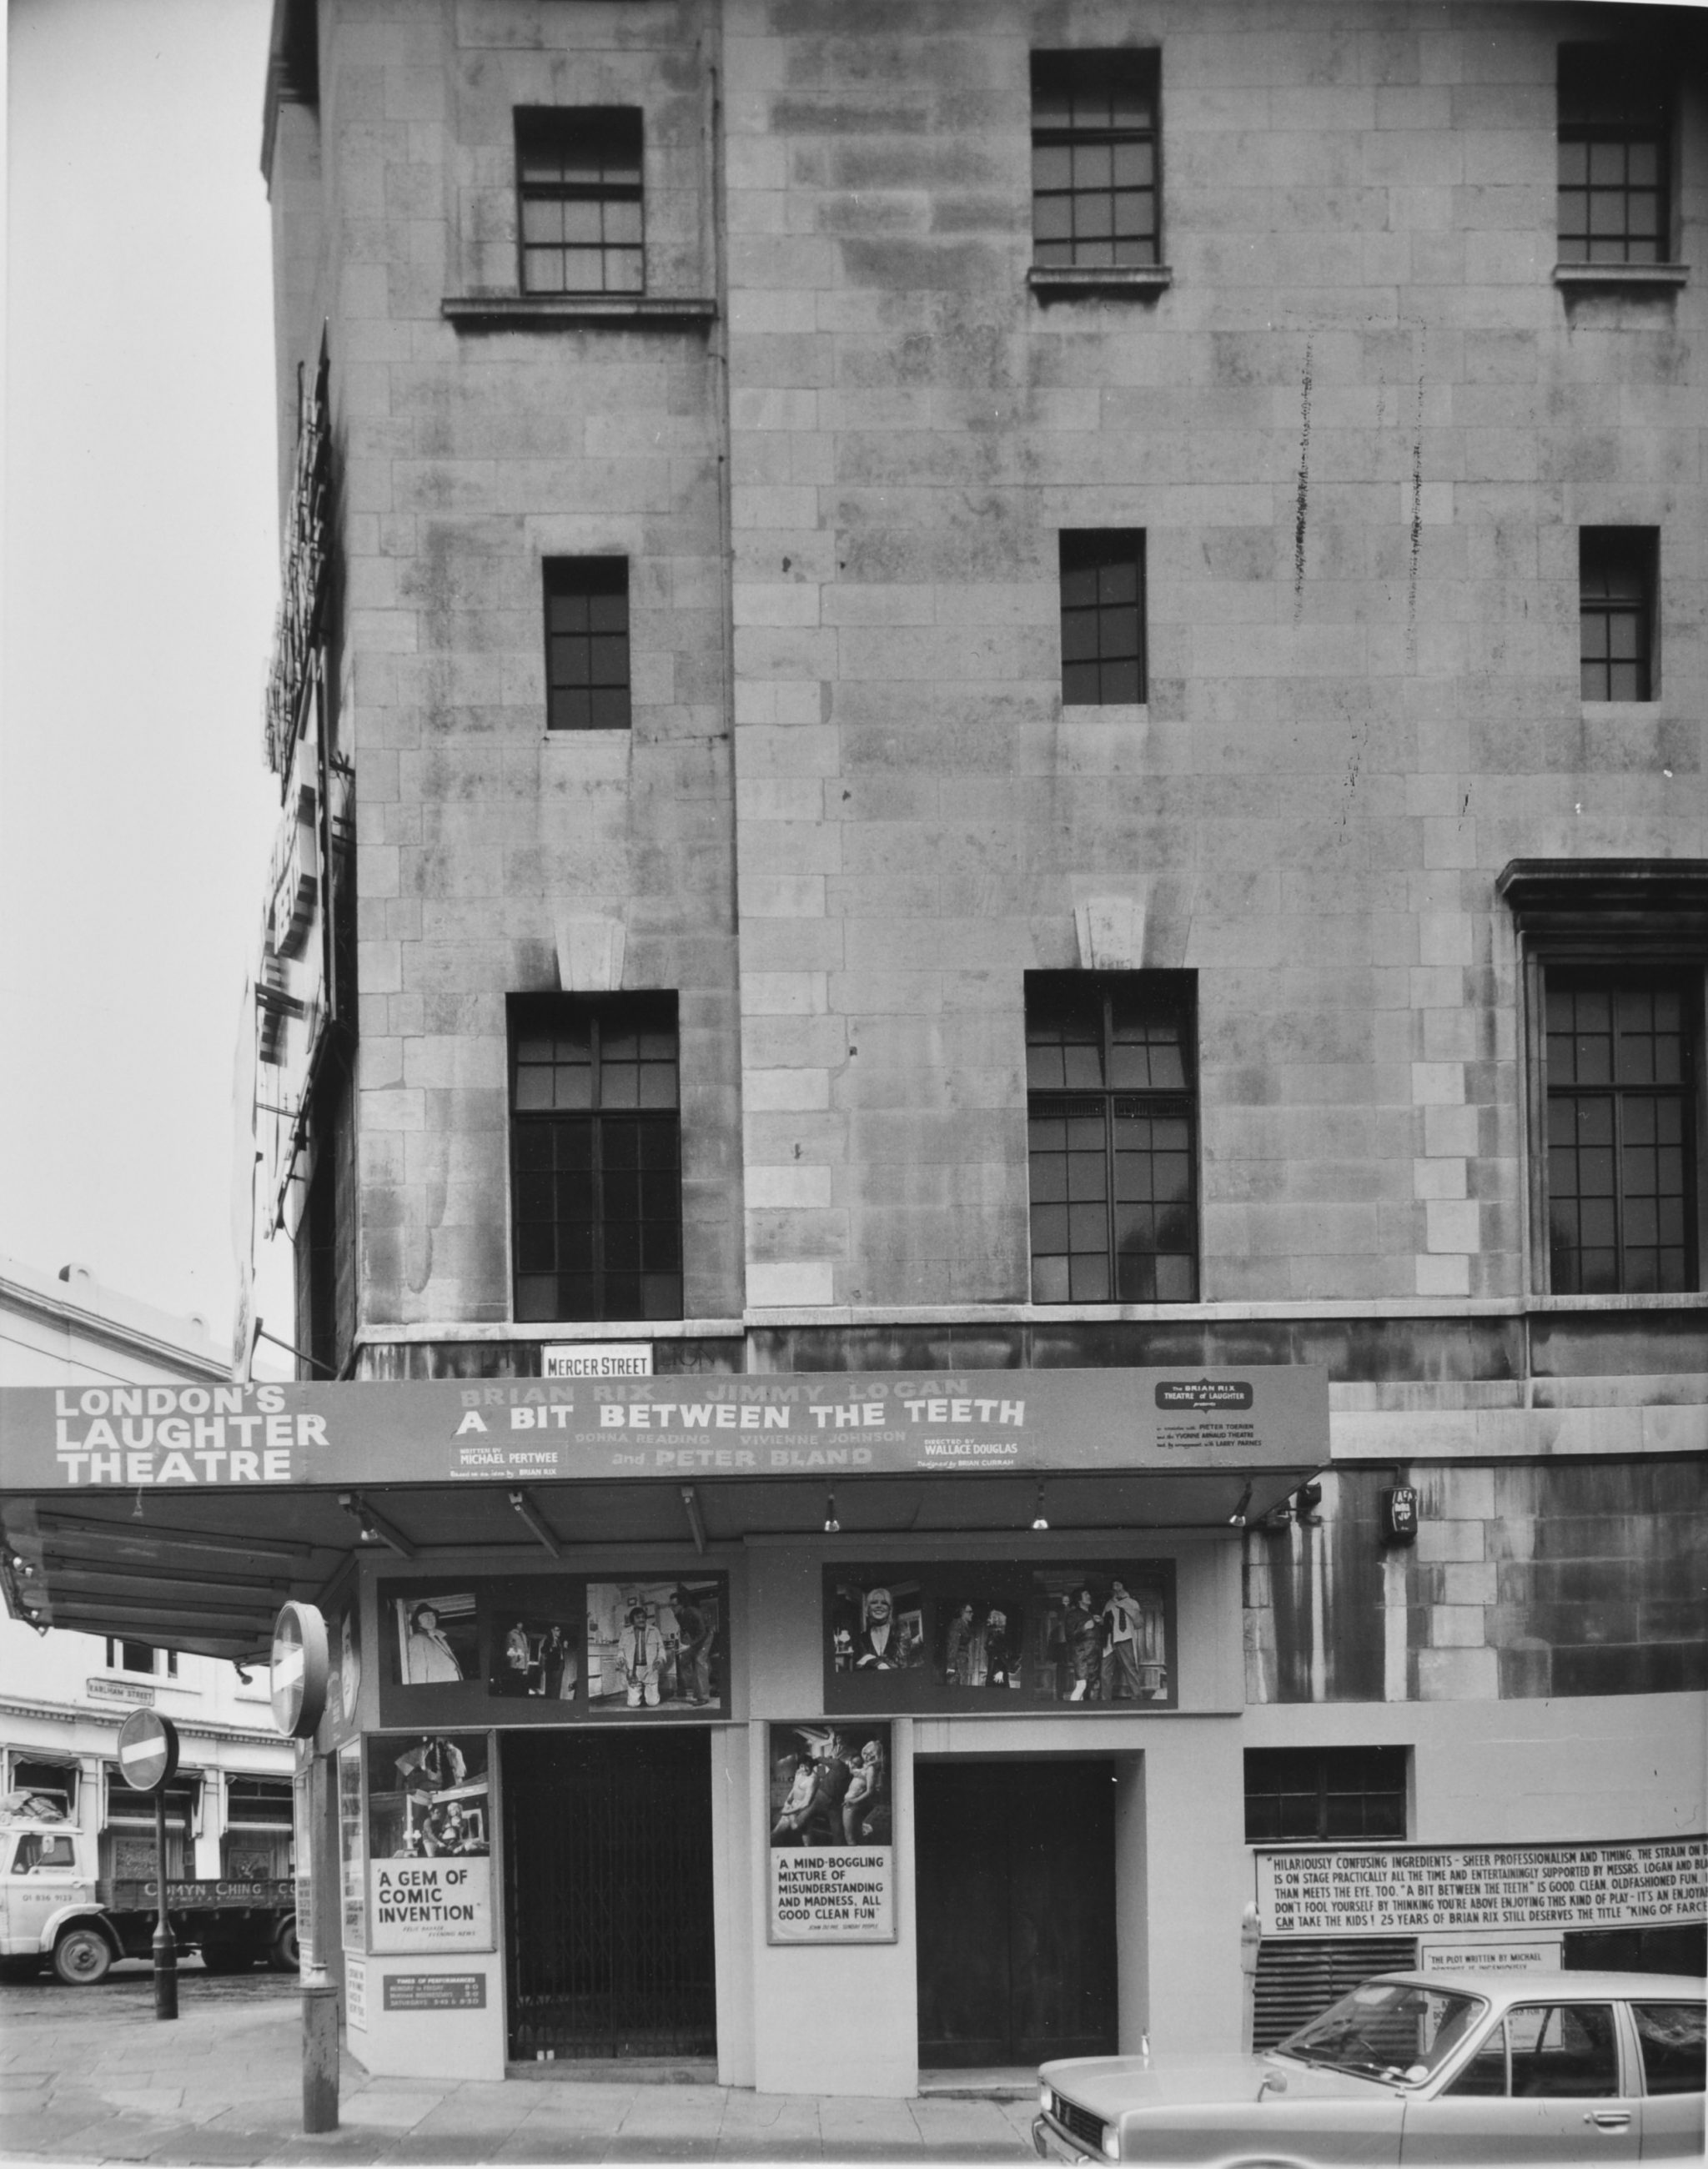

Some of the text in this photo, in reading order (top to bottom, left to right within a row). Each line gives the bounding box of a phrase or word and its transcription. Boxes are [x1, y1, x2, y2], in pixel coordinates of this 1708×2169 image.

[548, 1358, 598, 1376] MERCER
[601, 1357, 647, 1375] STREET
[55, 1383, 286, 1416] LONDON'S
[460, 1378, 968, 1407] BRIAN RIX JIMMY LOGAN
[455, 1398, 1025, 1435] A BIT BETWEEN THE TEETH
[56, 1414, 329, 1450] LAUGHTER
[575, 1431, 907, 1445] DONNA READING VIVIENNE JOHNSON
[612, 1448, 872, 1466] and PETER BLAND
[925, 1443, 1017, 1455] WALLACE DOUGLAS
[460, 1452, 558, 1464] MICHAEL PERTWEE
[57, 1450, 291, 1484] THEATRE
[89, 1684, 123, 1696] EARLHAM
[127, 1690, 152, 1700] STREET
[794, 1857, 884, 1869] MIND-BOGGLING
[1336, 1856, 1388, 1870] CONFUSING
[1392, 1855, 1452, 1869] INGREDIENTS
[1463, 1854, 1491, 1867] SHEER
[1494, 1851, 1576, 1865] PROFESSIONALISM
[1580, 1850, 1598, 1863] AND
[1638, 1848, 1652, 1860] THE
[1655, 1846, 1685, 1859] STRAIN
[1689, 1845, 1700, 1856] ON
[398, 1870, 437, 1886] GEM
[445, 1870, 468, 1885] OF
[778, 1870, 846, 1882] MIXTURE OF
[1274, 1873, 1283, 1885] IS
[1286, 1873, 1299, 1885] ON
[1303, 1872, 1329, 1884] STAGE
[1333, 1870, 1388, 1883] PRACTICALLY
[1392, 1870, 1406, 1882] ALL
[1408, 1870, 1423, 1881] THE
[1427, 1870, 1447, 1881] TIME
[1450, 1869, 1467, 1880] AND
[1471, 1867, 1539, 1880] ENTERTAININGLY
[1542, 1865, 1590, 1879] SUPPORTED
[1593, 1865, 1603, 1876] BY
[1644, 1860, 1673, 1874] LOGAN
[1675, 1860, 1692, 1871] AND
[216, 1882, 261, 1895] CHING
[778, 1883, 884, 1895] MISUNDERSTANDING
[1275, 1888, 1299, 1900] THAN
[1303, 1886, 1330, 1899] MEETS
[1334, 1886, 1351, 1898] THE
[1419, 1885, 1434, 1895] BIT
[1439, 1883, 1480, 1895] BETWEEN
[1484, 1882, 1500, 1894] THE
[1538, 1881, 1546, 1892] IS
[1611, 1875, 1676, 1890] OLDFASHIONED
[379, 1888, 442, 1904] COMIC
[778, 1895, 881, 1907] AND MADNESS, ALL
[1275, 1901, 1301, 1914] DON'T
[1305, 1901, 1328, 1912] FOOL
[1331, 1900, 1374, 1912] YOURSELF
[1378, 1900, 1389, 1911] BY
[1393, 1899, 1434, 1911] THINKING
[1437, 1898, 1466, 1910] YOU'RE
[1470, 1897, 1498, 1909] ABOVE
[1501, 1896, 1545, 1909] ENJOYING
[1547, 1895, 1566, 1907] THIS
[1570, 1894, 1591, 1906] KIND
[1595, 1893, 1606, 1905] OF
[1637, 1890, 1654, 1902] IT'S
[1656, 1890, 1669, 1901] AN
[778, 1910, 810, 1920] GOOD
[815, 1908, 849, 1920] CLEAN
[1275, 1916, 1294, 1928] CAN
[1298, 1915, 1322, 1926] TAKE
[1325, 1915, 1342, 1926] THE
[1381, 1915, 1394, 1925] 25
[1397, 1914, 1429, 1925] YEARS
[1433, 1913, 1444, 1924] OF
[1449, 1912, 1479, 1924] BRIAN
[1483, 1911, 1499, 1923] RIX
[1503, 1910, 1525, 1922] STILL
[1529, 1909, 1573, 1922] DESERVES
[1578, 1908, 1594, 1920] THE
[1597, 1906, 1621, 1918] TITLE
[1660, 1903, 1673, 1915] OF
[1446, 1955, 1462, 1964] PLOT
[1465, 1953, 1495, 1963] WRITTEN
[1499, 1953, 1507, 1962] BY
[1510, 1952, 1541, 1961] MICHAEL
